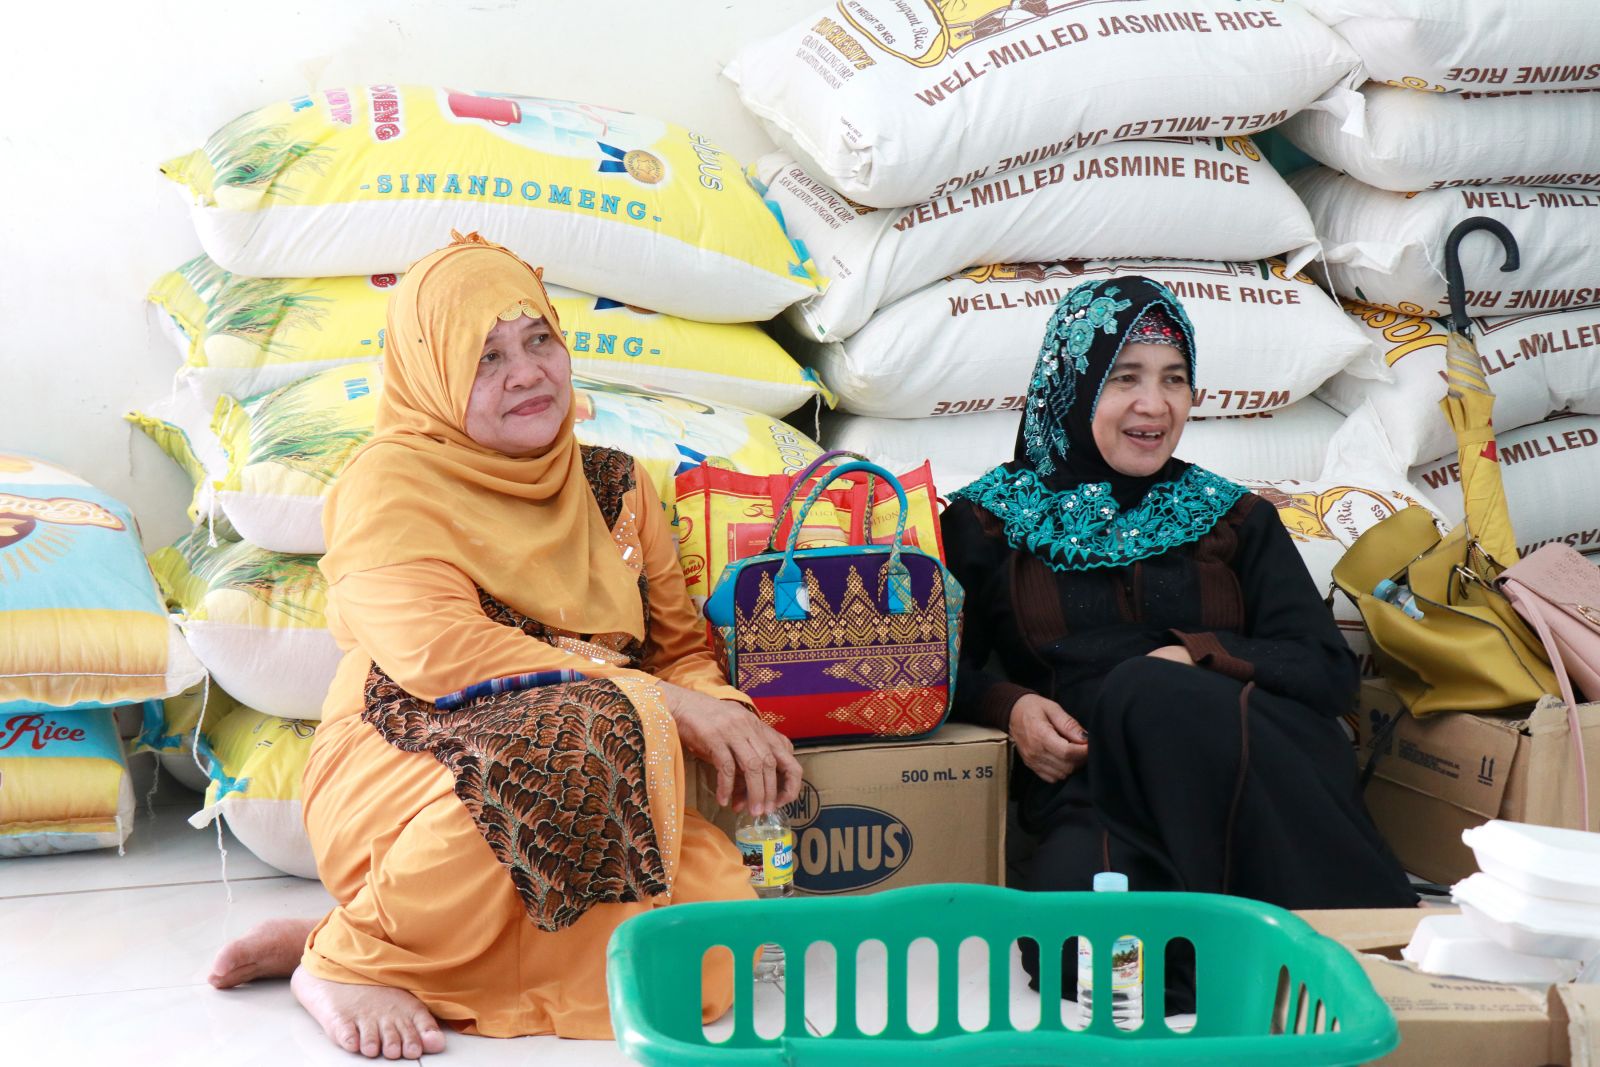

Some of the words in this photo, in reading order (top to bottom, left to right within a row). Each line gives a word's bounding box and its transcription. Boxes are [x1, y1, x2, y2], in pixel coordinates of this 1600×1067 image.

[856, 6, 879, 25] WEIGHT
[874, 23, 886, 33] 50
[880, 30, 897, 45] KGS
[912, 27, 929, 50] Rice
[815, 43, 841, 70] MILLING
[915, 22, 1089, 106] WELL-MILLED
[1097, 12, 1212, 38] JASMINE
[1215, 10, 1282, 32] RICE
[1443, 66, 1508, 84] RICE
[1513, 63, 1600, 84] SMINE
[1113, 108, 1289, 140] WELL-MILLED
[994, 129, 1108, 176] JASMINE
[789, 168, 813, 188] GRAIN
[810, 183, 840, 209] MILLING
[834, 206, 855, 224] CORP.
[892, 162, 1065, 232] WELL-MILLED
[1073, 156, 1185, 183] JASMINE
[1195, 160, 1250, 185] RICE
[929, 164, 991, 200] RICE
[1461, 189, 1600, 210] WELL-MILL
[1164, 280, 1231, 302] MINE
[1239, 286, 1301, 305] RICE
[1504, 287, 1600, 309] SMINE
[930, 397, 996, 416] RICE
[1, 713, 86, 750] Rice
[901, 769, 929, 783] 500
[933, 768, 956, 781] mL
[962, 768, 971, 779] x
[975, 766, 993, 779] 35
